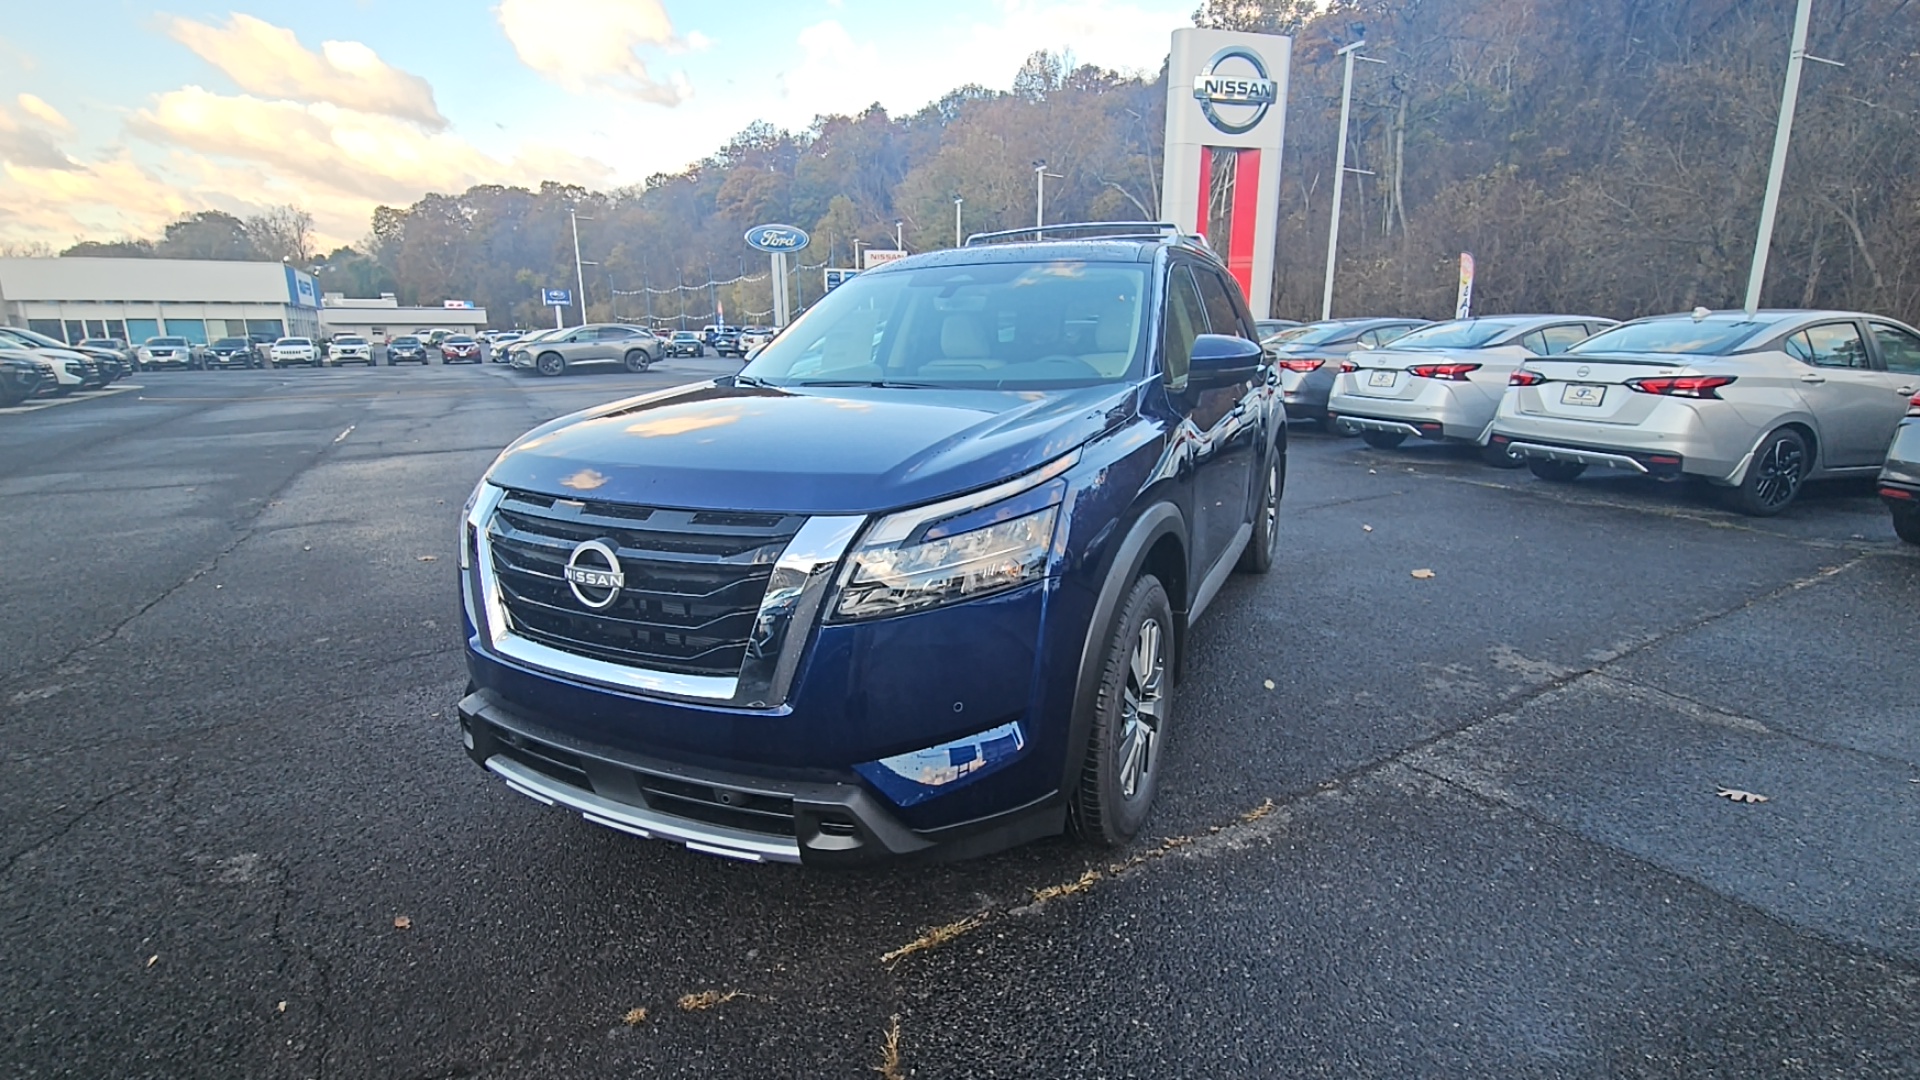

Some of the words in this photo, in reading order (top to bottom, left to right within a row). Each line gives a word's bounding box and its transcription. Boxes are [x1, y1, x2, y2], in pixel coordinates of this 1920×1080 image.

[1204, 80, 1271, 97] NISSAN
[760, 230, 796, 247] Ford
[564, 567, 622, 587] NISSAN
